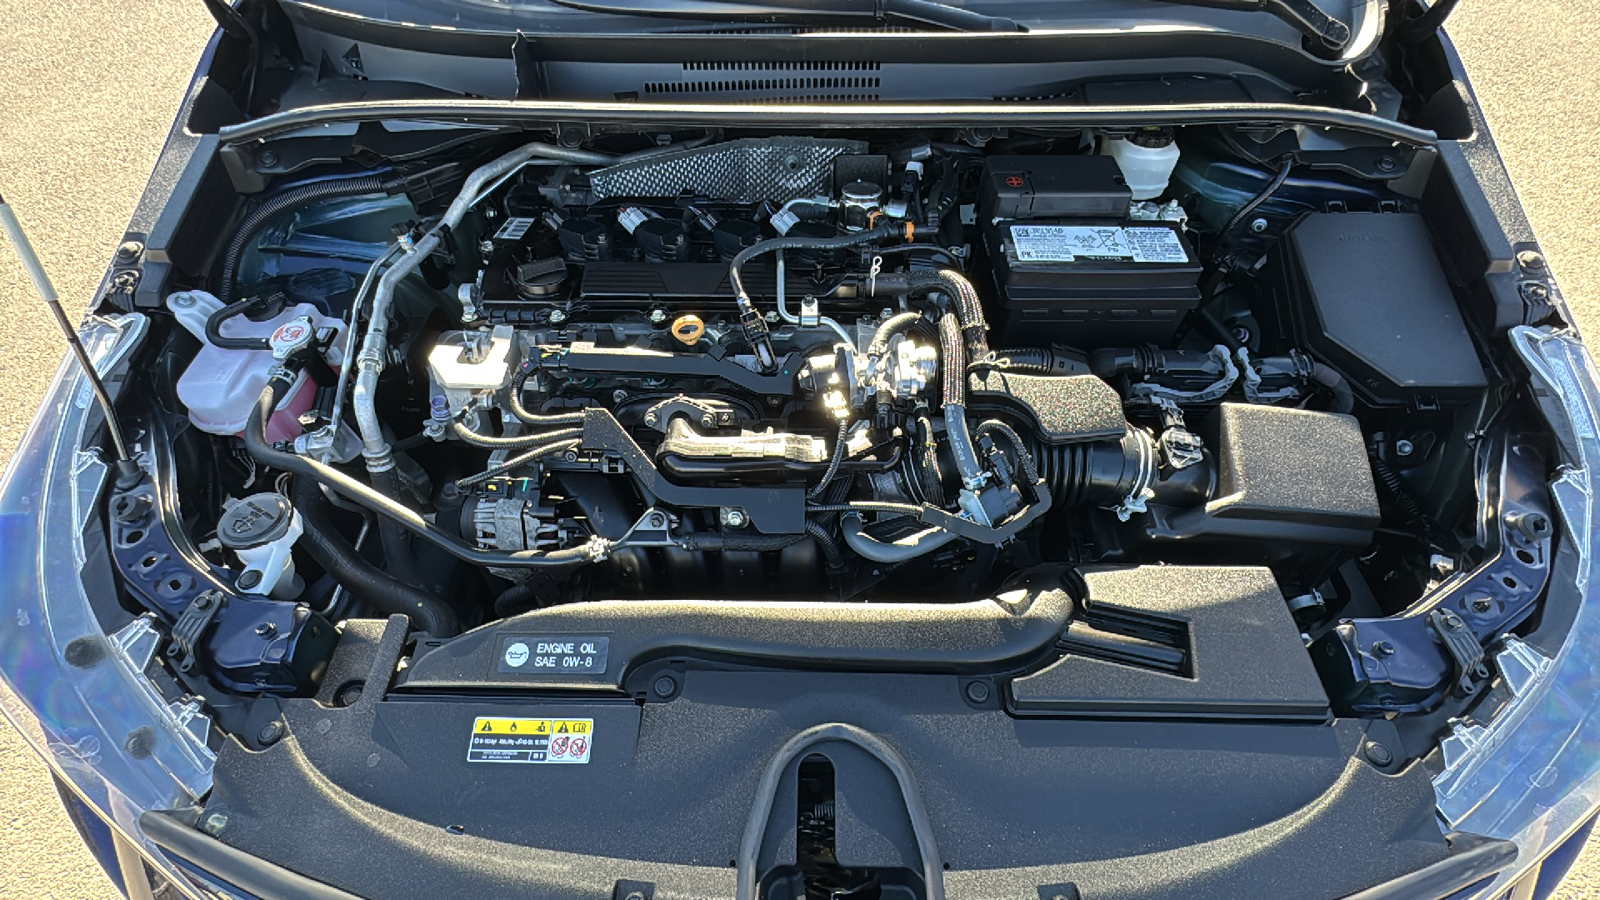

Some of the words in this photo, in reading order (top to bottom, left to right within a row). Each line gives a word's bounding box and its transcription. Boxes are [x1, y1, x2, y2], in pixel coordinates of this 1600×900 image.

[536, 642, 575, 654] ENGINE
[580, 642, 598, 654] OIL
[534, 656, 557, 667] SAE
[562, 656, 593, 668] 0W-8
